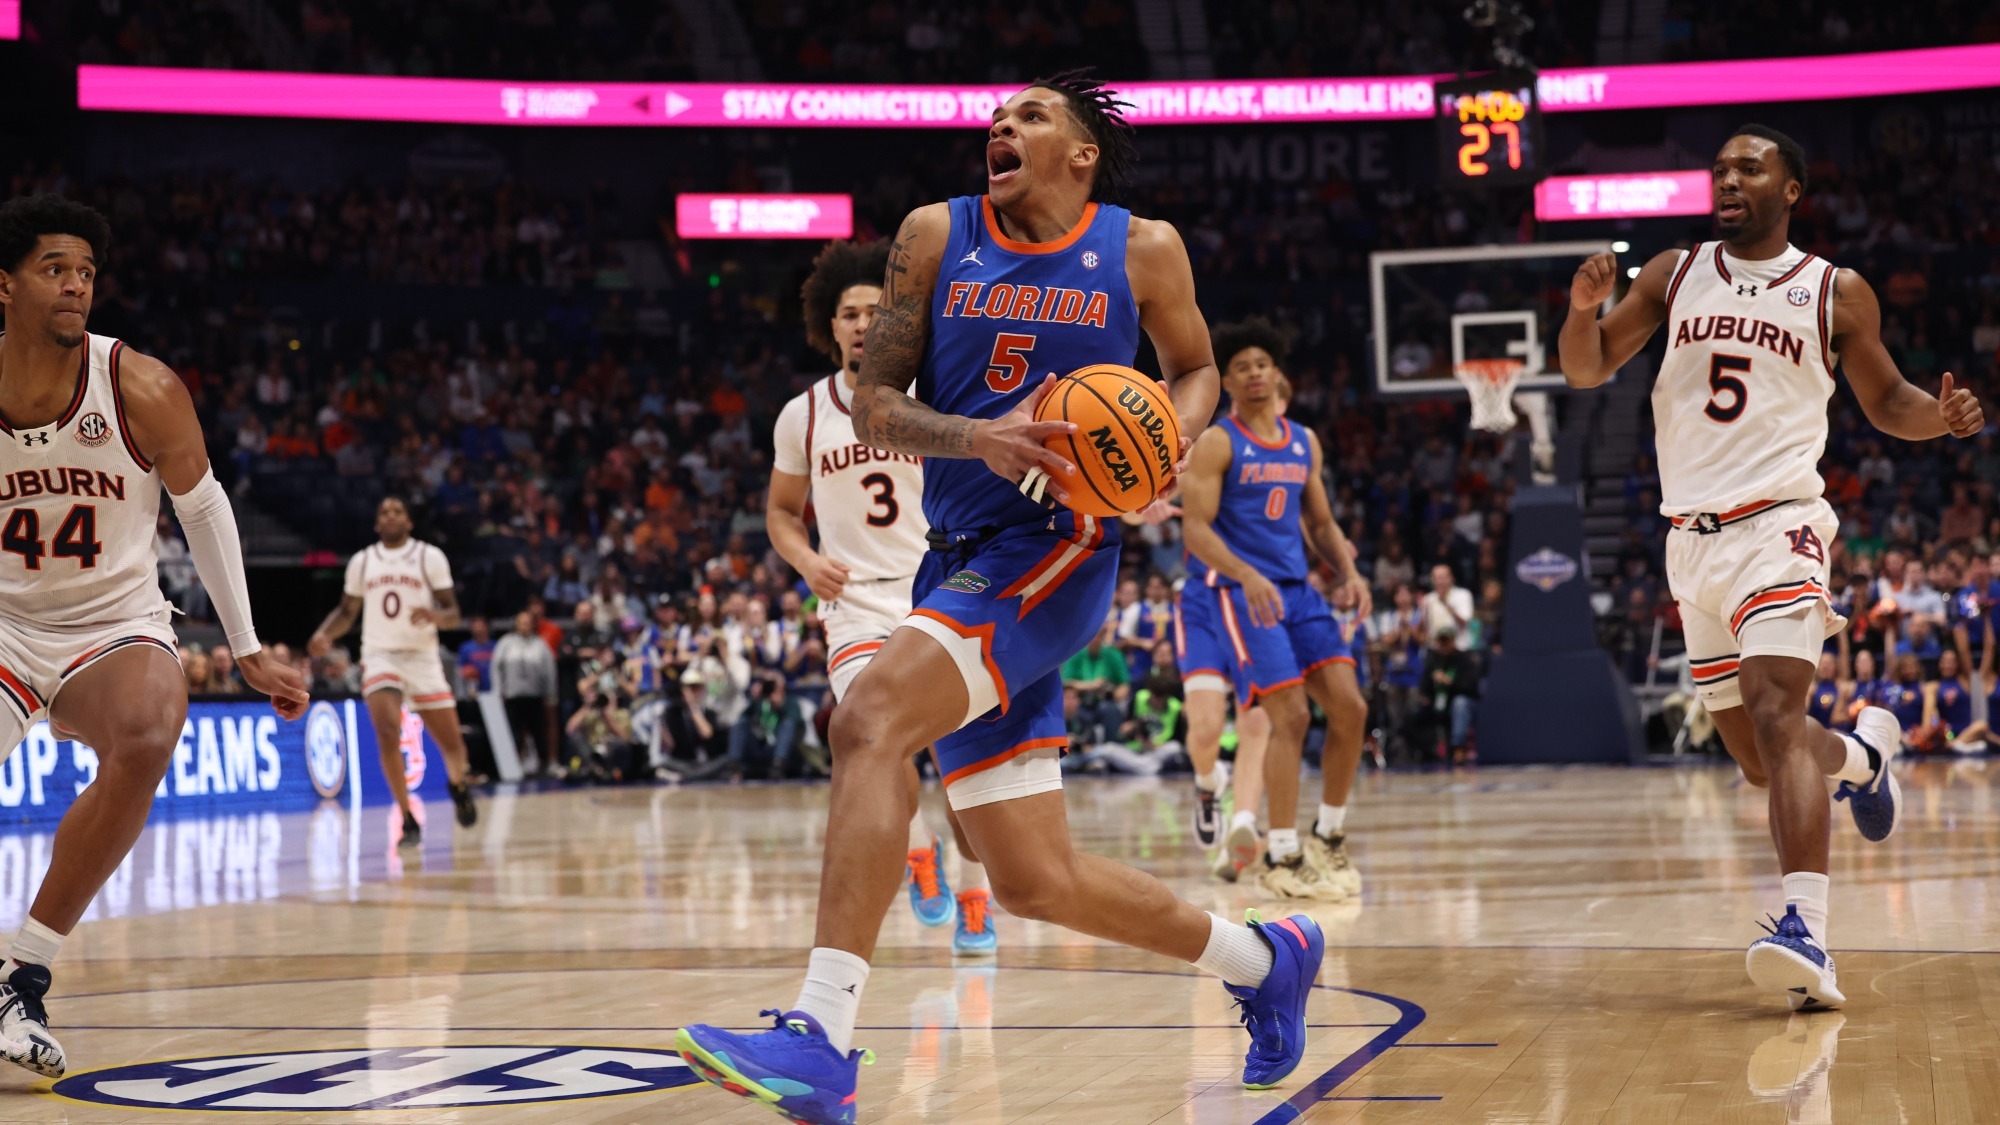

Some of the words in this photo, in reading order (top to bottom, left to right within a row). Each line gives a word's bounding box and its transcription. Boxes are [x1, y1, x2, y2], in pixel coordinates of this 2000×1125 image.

[722, 89, 788, 119] STAY
[791, 90, 957, 121] CONNECTED
[959, 91, 998, 120] TO
[1189, 86, 1261, 118] FAST,
[1264, 84, 1387, 113] RELIABLE
[1389, 81, 1433, 111] HO
[1211, 129, 1392, 182] MORE
[1458, 122, 1521, 176] 27
[1082, 252, 1099, 268] SEC
[942, 282, 1108, 328] FLORIDA
[1788, 287, 1810, 306] SEC
[984, 332, 1036, 394] 5
[1674, 315, 1804, 367] AUBURN
[1704, 352, 1752, 424] 5
[79, 434, 109, 446] GRADUATE
[81, 413, 106, 438] SEC
[1117, 385, 1172, 478] Wilson
[1088, 425, 1140, 493] NCAA
[860, 472, 899, 528] 3
[1264, 486, 1288, 520] 0
[1, 503, 102, 570] 44
[383, 591, 401, 619] 0
[155, 715, 281, 798] EAMS
